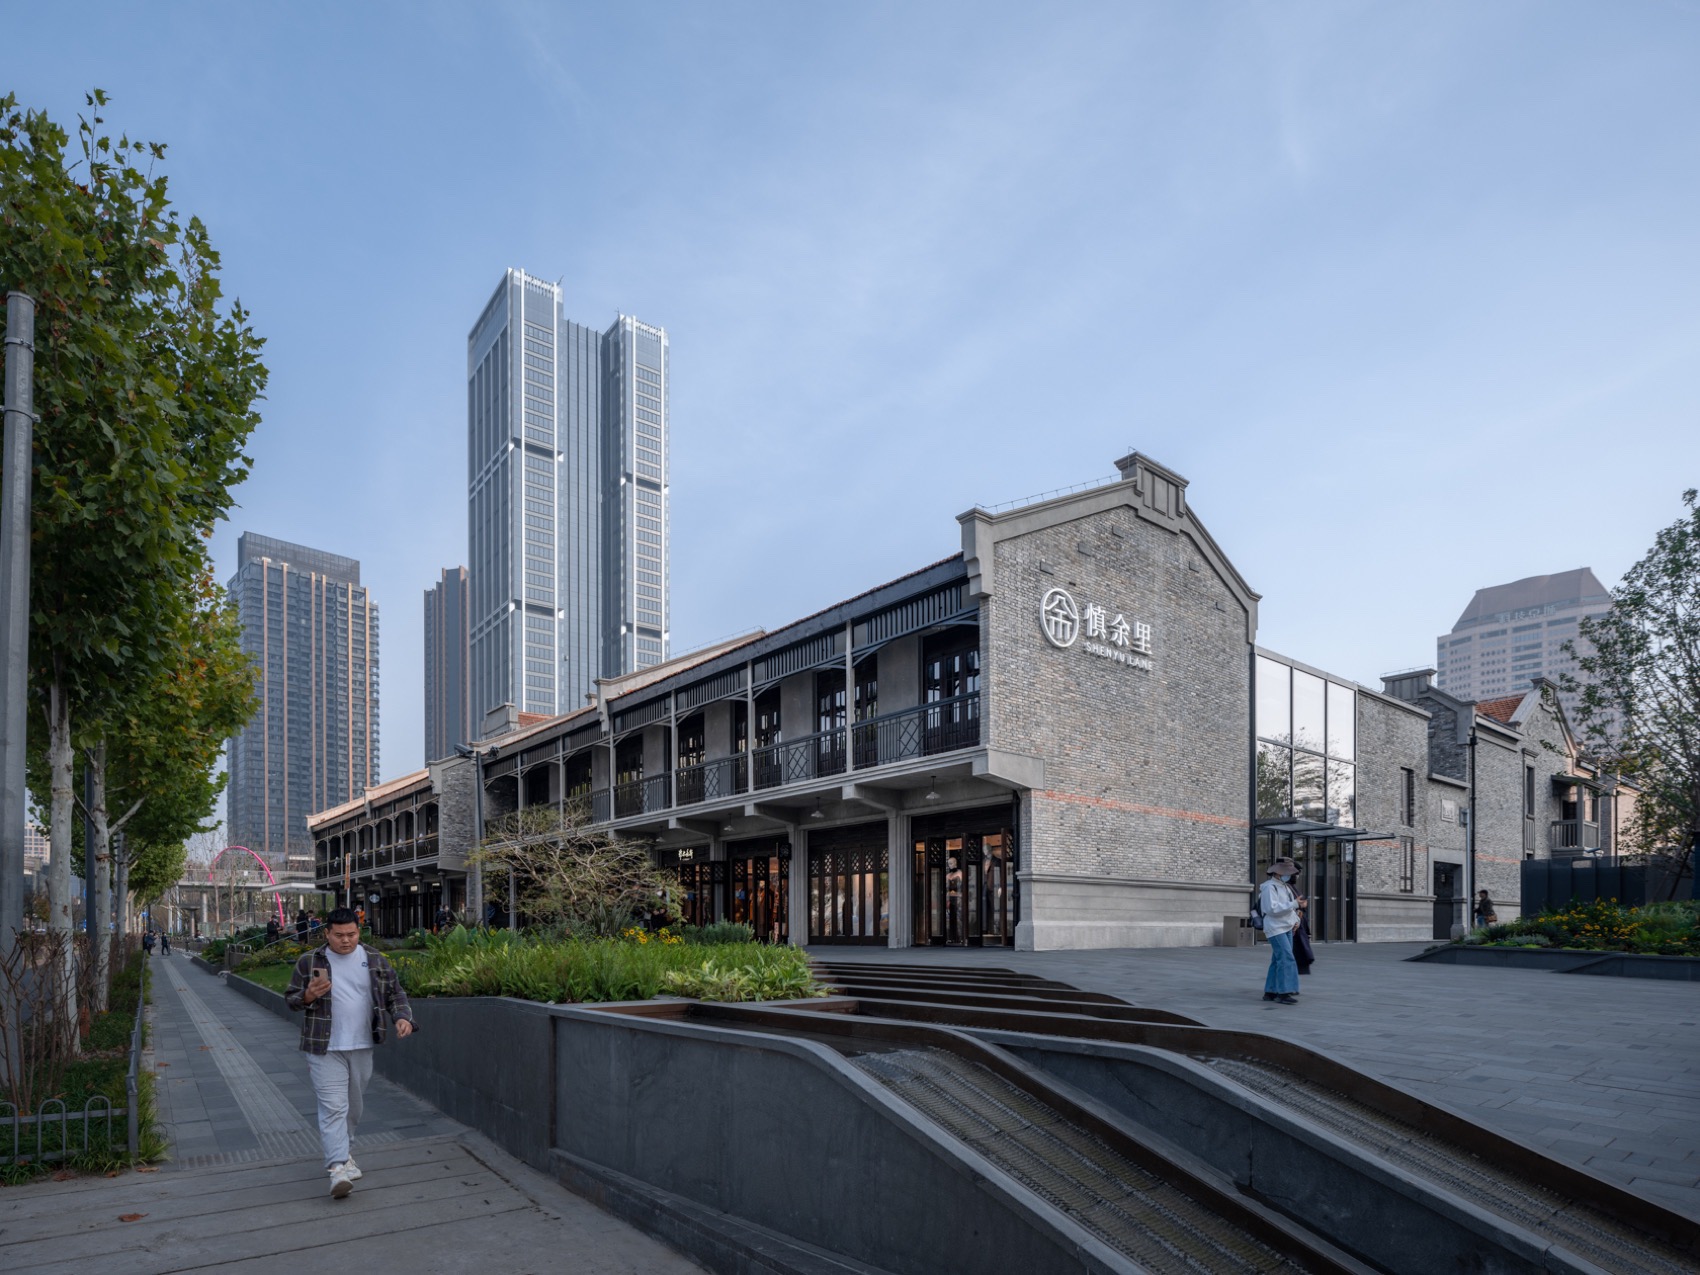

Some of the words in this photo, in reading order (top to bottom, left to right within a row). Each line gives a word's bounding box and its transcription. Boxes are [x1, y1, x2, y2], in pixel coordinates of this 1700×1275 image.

[1083, 602, 1153, 655] 慎余里
[1085, 641, 1125, 662] SHENYU
[1127, 655, 1153, 671] LANE
